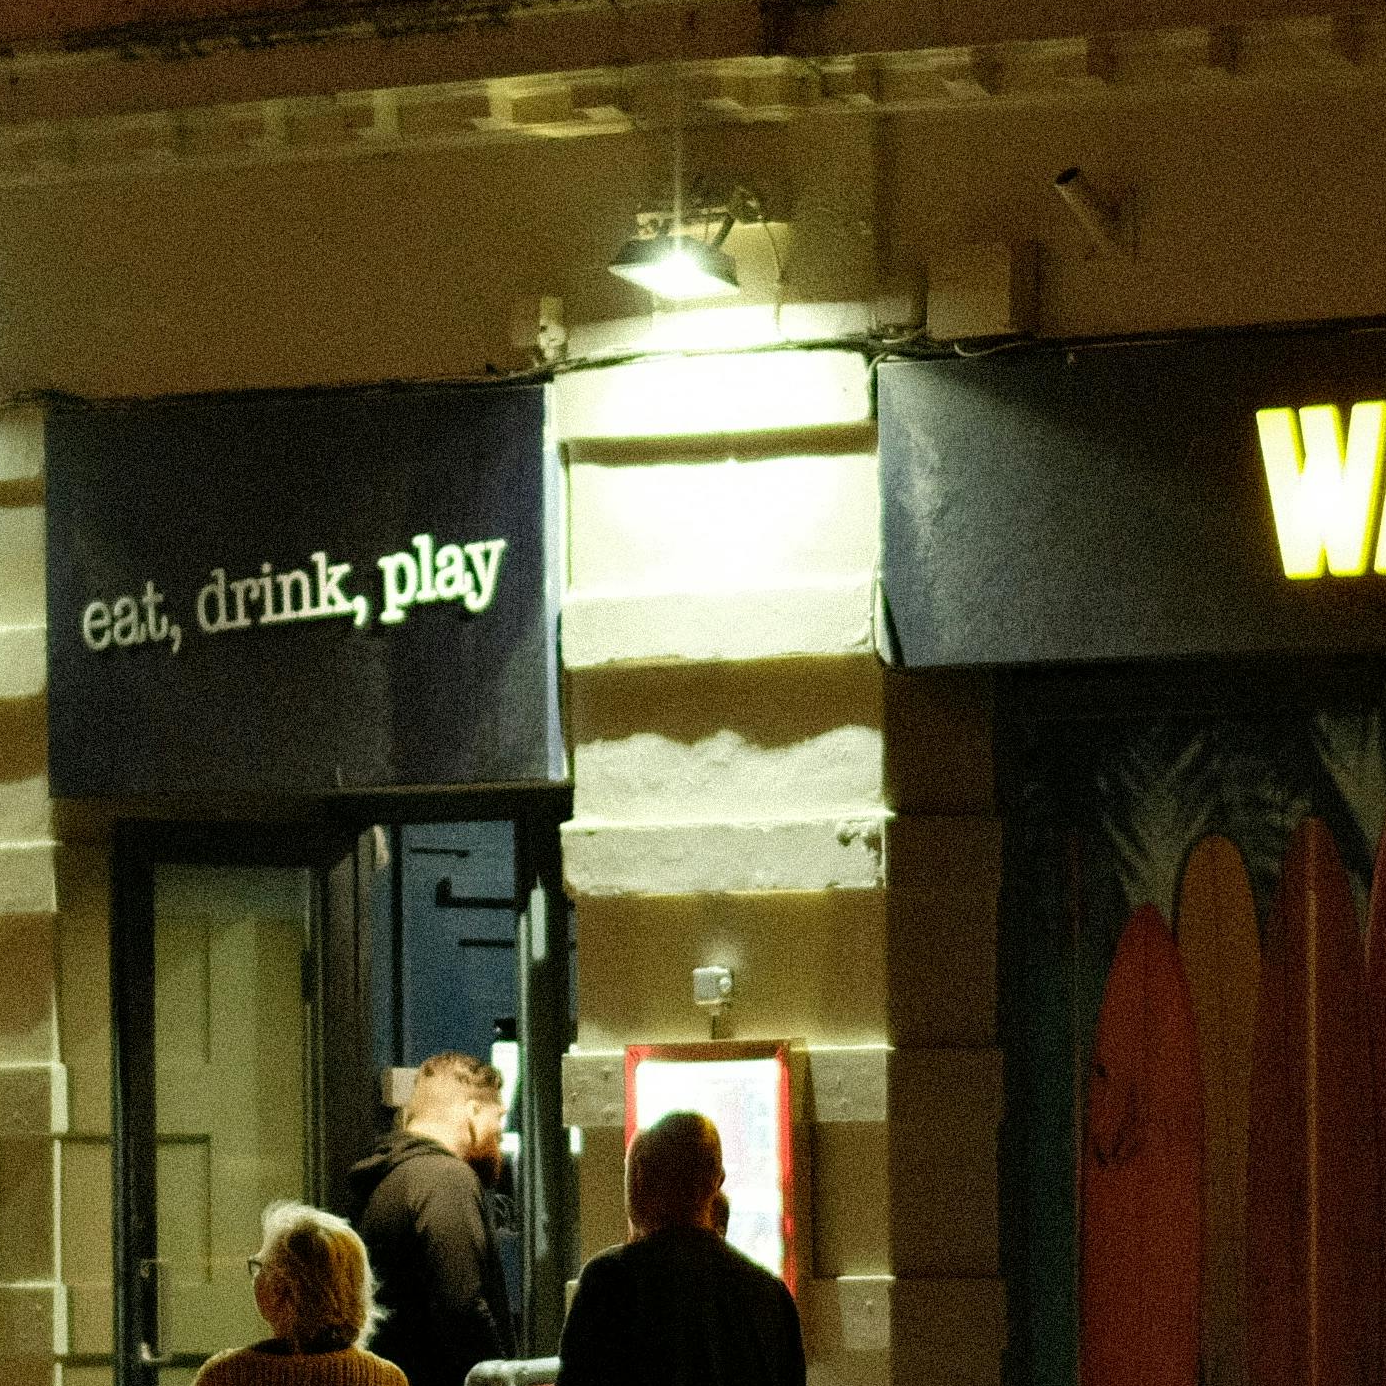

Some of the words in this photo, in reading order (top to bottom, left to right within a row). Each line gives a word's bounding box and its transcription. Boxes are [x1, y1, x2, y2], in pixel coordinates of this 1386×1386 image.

[81, 579, 183, 654] eat,
[196, 550, 370, 634] drink,
[376, 532, 508, 624] play
